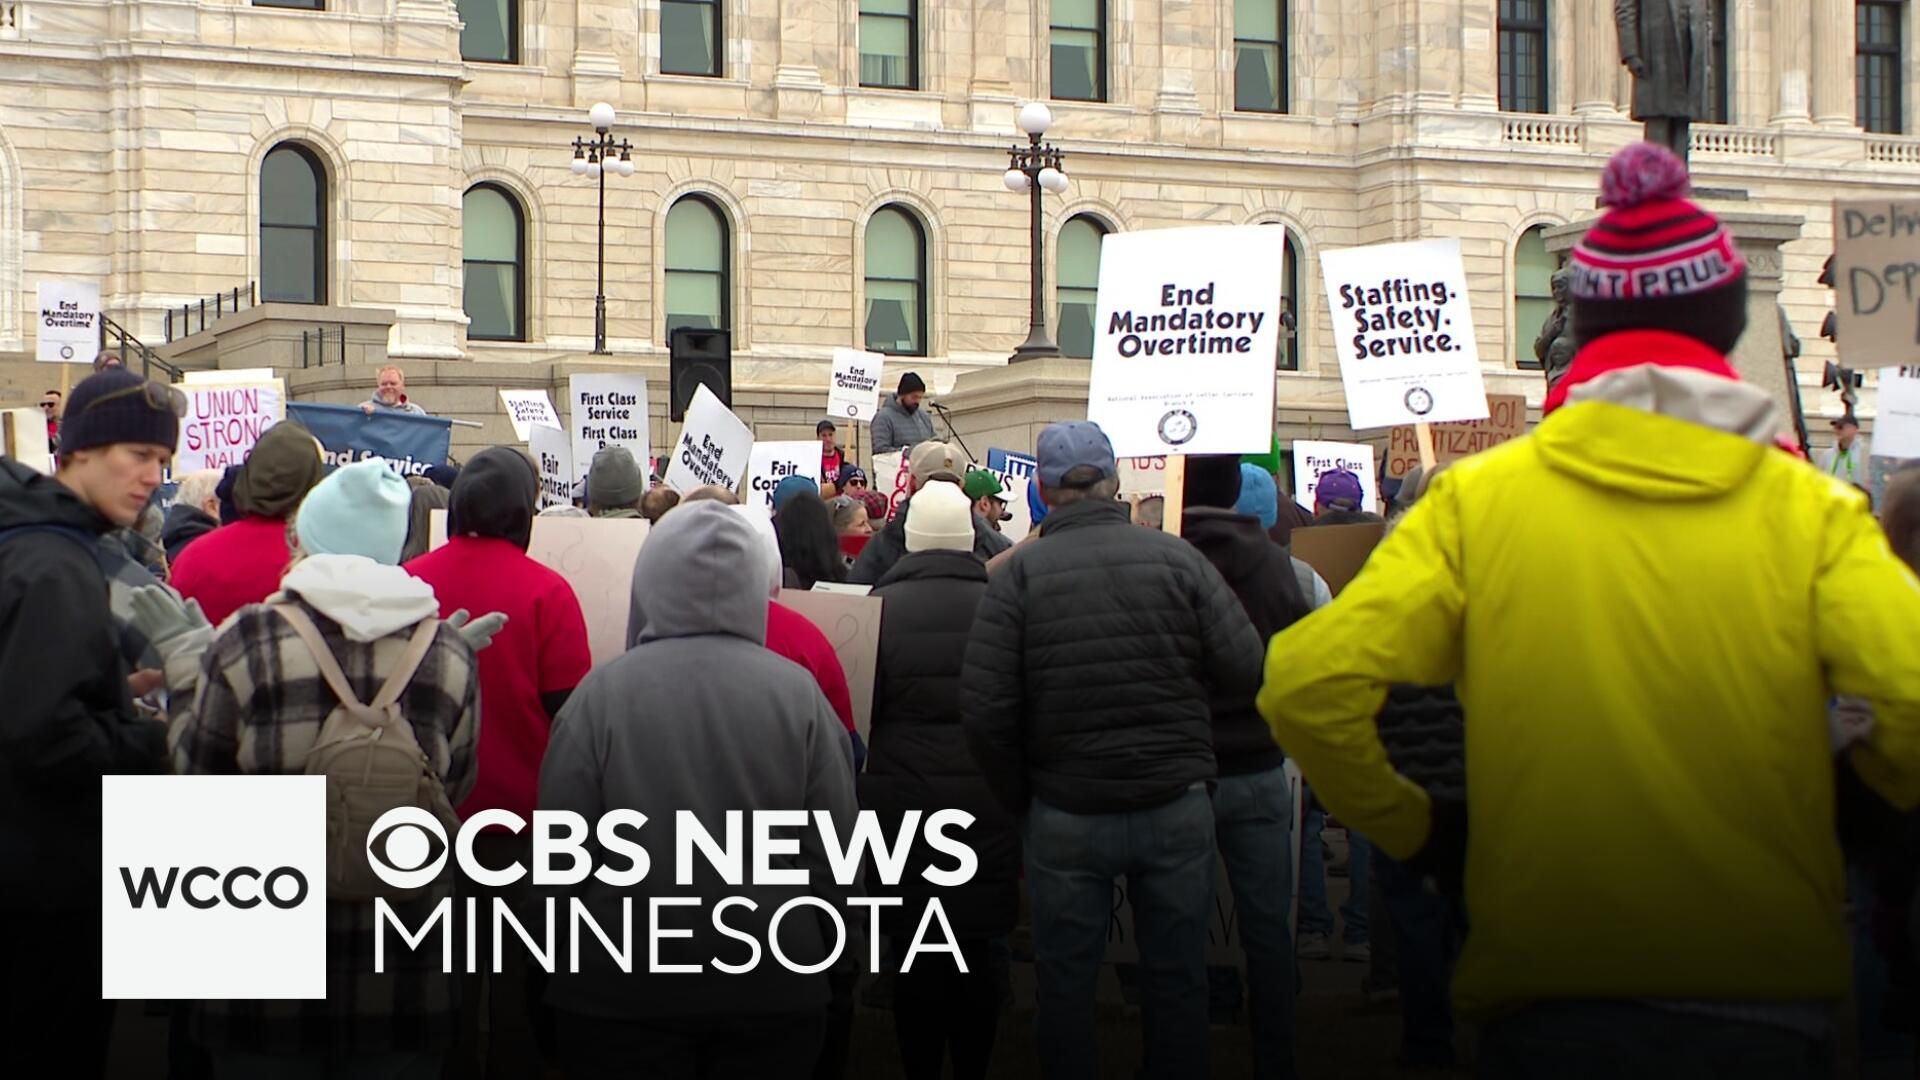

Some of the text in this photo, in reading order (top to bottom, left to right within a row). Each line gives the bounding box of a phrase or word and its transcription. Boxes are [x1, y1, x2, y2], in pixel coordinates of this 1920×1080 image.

[1639, 253, 1727, 297] PAUL
[59, 301, 78, 310] End
[1161, 282, 1214, 307] End
[1339, 279, 1457, 309] Staffing.
[42, 309, 95, 321] Mandatory
[45, 317, 91, 328] Overtime
[1108, 308, 1265, 335] Mandatory
[1354, 305, 1451, 333] Safety.
[1118, 331, 1252, 358] Overtime
[1353, 329, 1461, 360] Service.
[834, 372, 878, 386] Mandatory
[850, 366, 865, 375] End
[837, 380, 874, 392] Overtime
[195, 388, 258, 419] UNION
[581, 392, 636, 406] First Class
[588, 406, 630, 420] Service
[582, 426, 637, 440] First Class
[703, 433, 724, 462] End
[324, 449, 433, 475] nd Srvic
[541, 452, 559, 475] Fair
[682, 432, 734, 490] Mandatory
[682, 450, 716, 485] Overti
[771, 460, 798, 476] Fair
[1306, 456, 1363, 470] First Class
[539, 477, 570, 498] ontract
